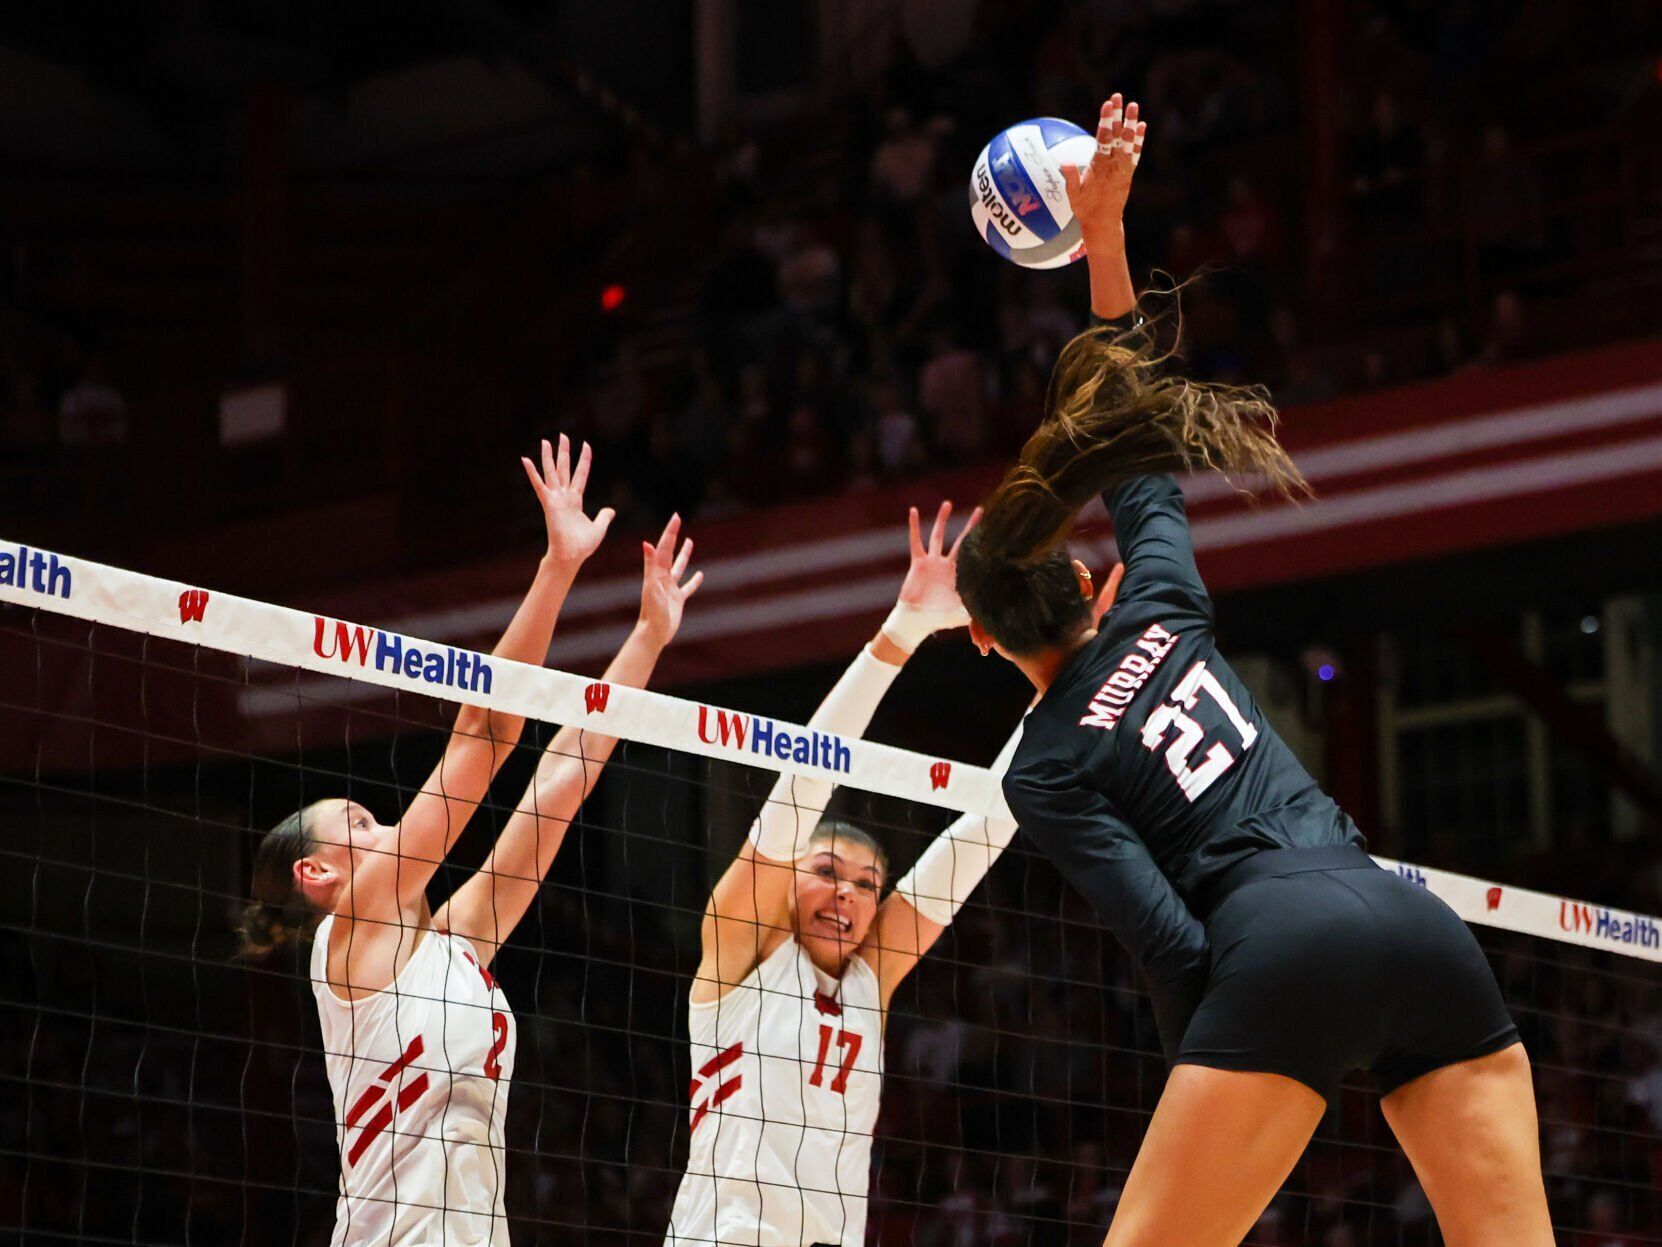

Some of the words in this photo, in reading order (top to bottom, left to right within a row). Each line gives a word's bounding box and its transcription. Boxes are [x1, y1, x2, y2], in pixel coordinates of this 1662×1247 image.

[976, 163, 1022, 236] molten
[1079, 623, 1180, 730] MURRAY
[1140, 660, 1258, 803] 27
[483, 1012, 508, 1082] 2
[808, 1024, 863, 1095] 17
